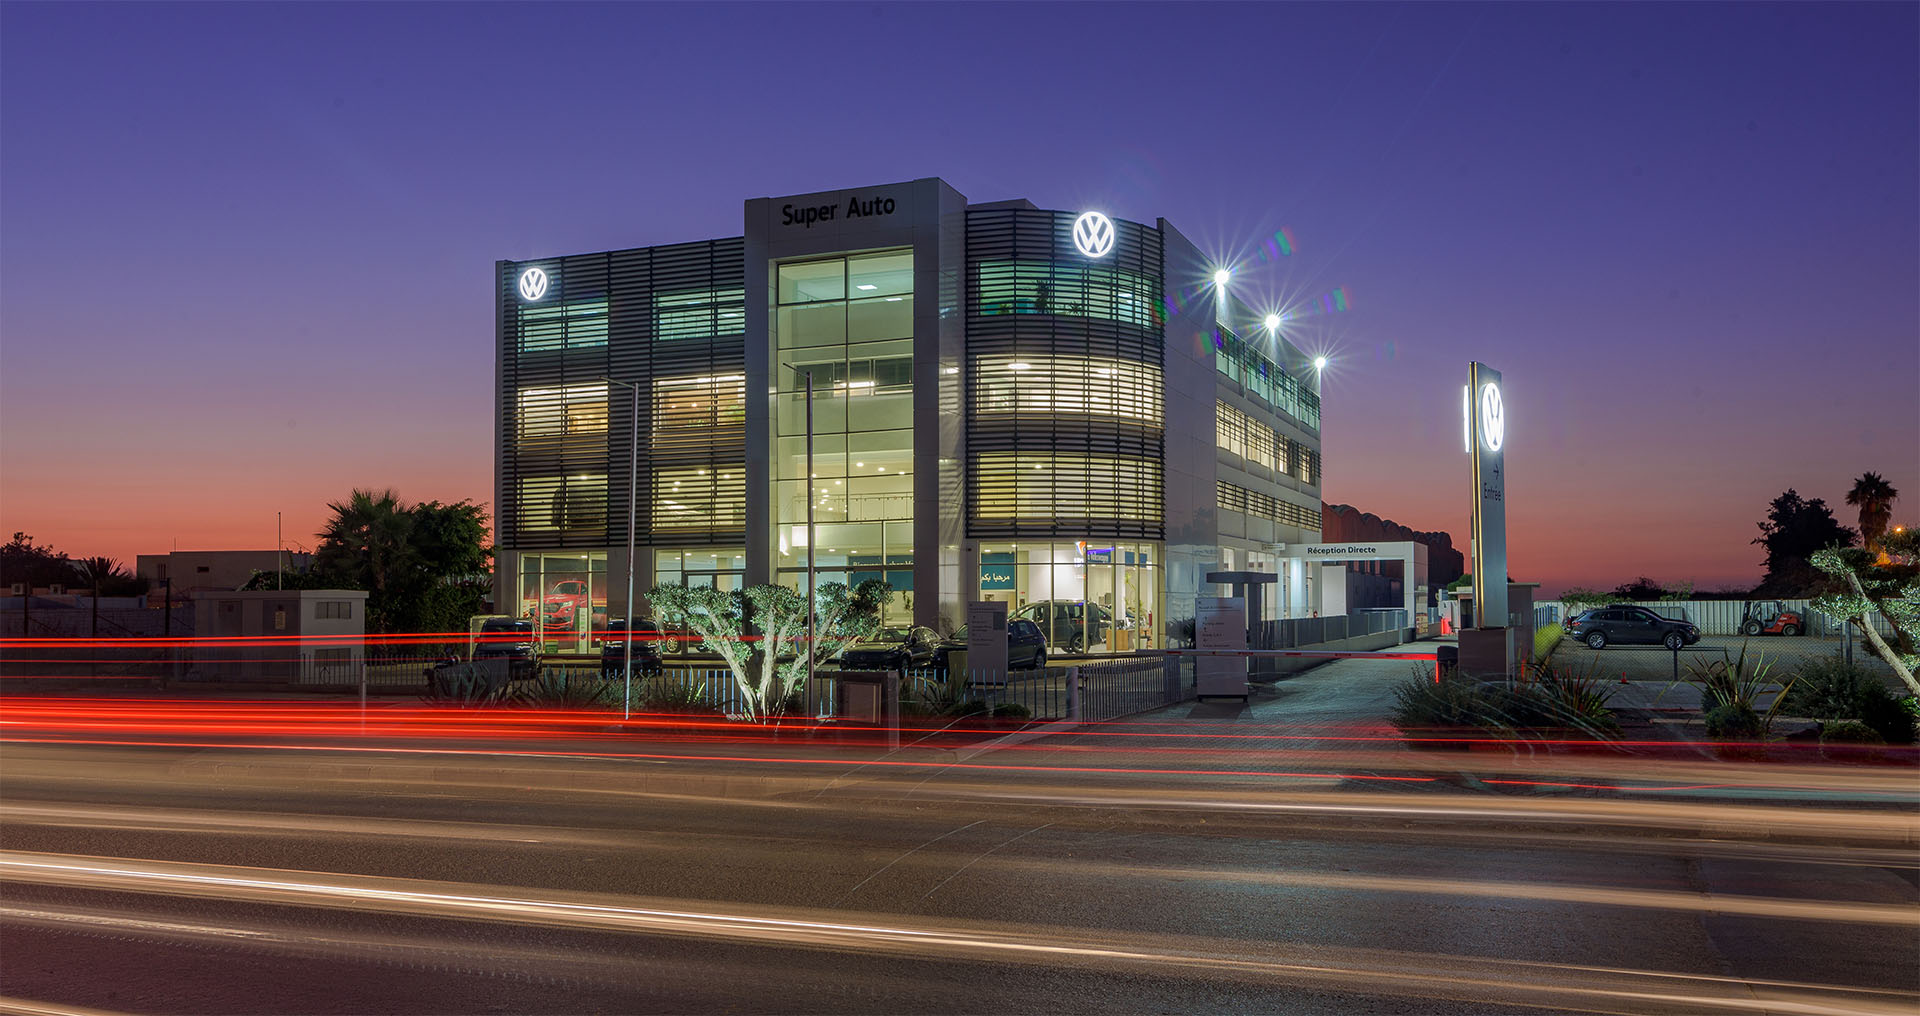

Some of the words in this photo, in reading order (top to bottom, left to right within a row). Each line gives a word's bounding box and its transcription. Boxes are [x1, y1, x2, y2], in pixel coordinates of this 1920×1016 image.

[782, 204, 838, 229] Super
[846, 196, 896, 219] Auto
[1307, 546, 1346, 555] Réception
[1347, 546, 1377, 554] Directe
